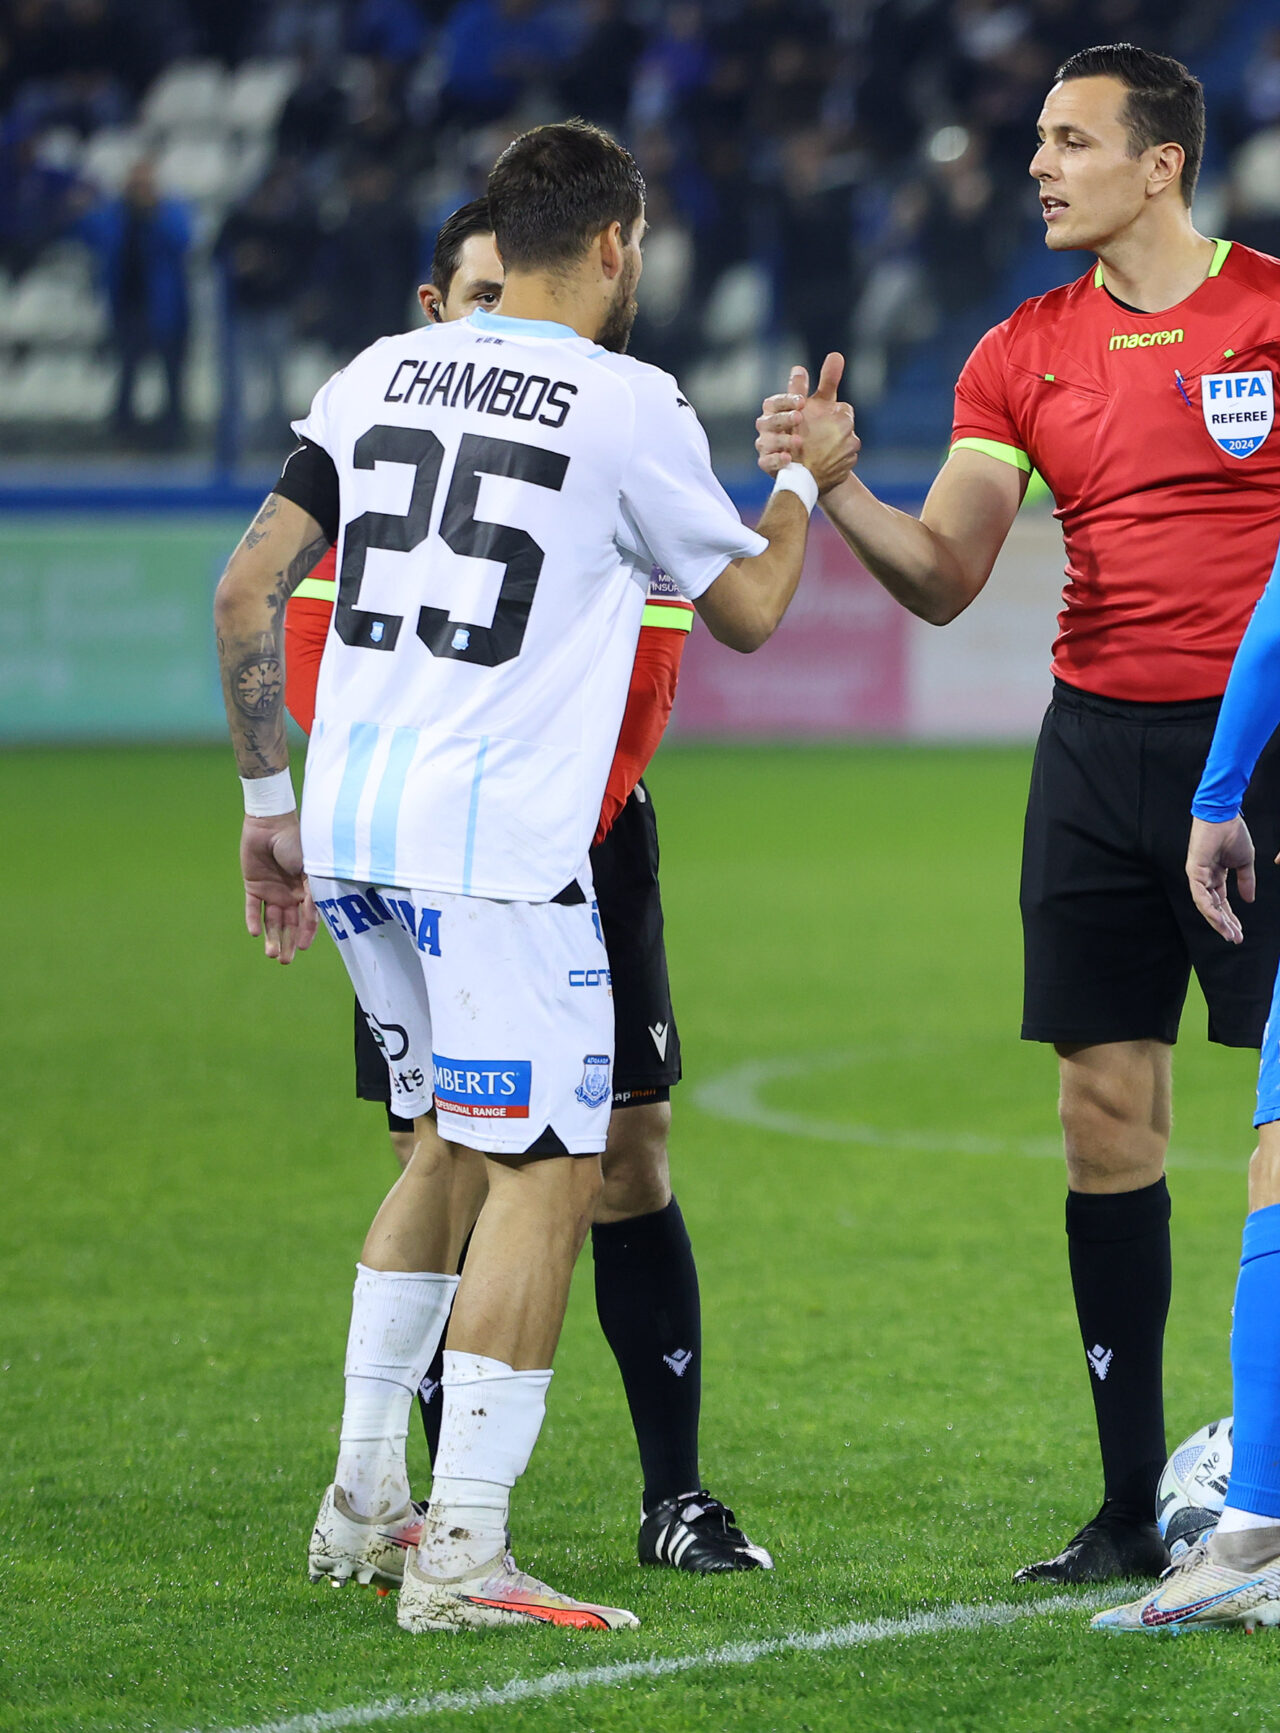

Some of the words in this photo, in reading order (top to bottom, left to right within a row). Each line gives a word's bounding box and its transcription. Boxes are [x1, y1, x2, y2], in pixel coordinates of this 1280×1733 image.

[1109, 327, 1184, 351] macron
[385, 359, 578, 428] CHAMBOS
[1209, 377, 1267, 399] FIFA
[1211, 411, 1268, 424] REFEREE
[1229, 439, 1254, 450] 2024
[334, 424, 571, 668] 25
[472, 1107, 507, 1117] RANGE
